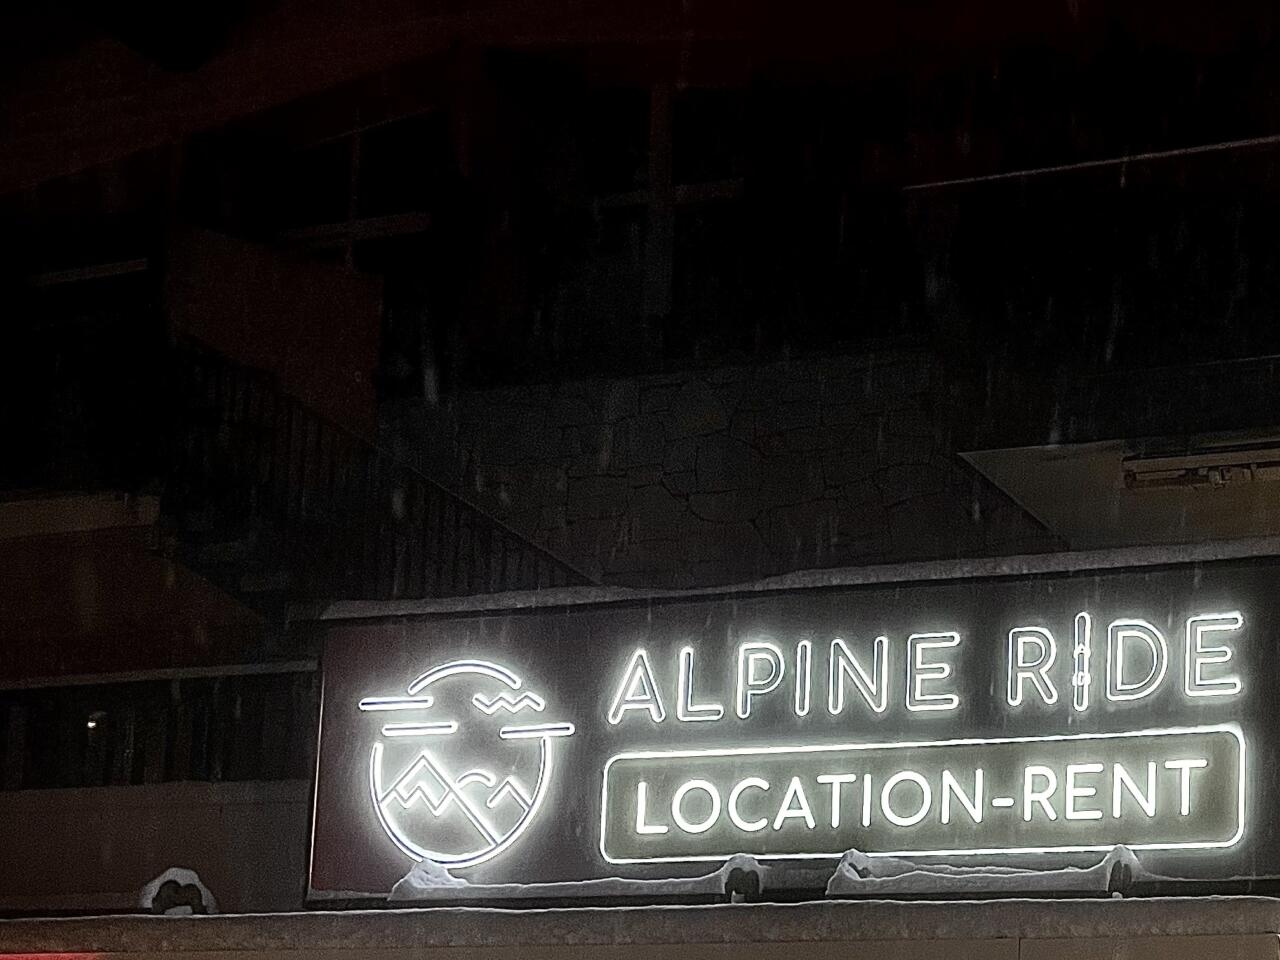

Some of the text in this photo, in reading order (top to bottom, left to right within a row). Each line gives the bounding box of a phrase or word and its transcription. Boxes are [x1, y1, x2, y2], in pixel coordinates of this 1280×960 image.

[608, 611, 1246, 726] ALPINE RIDE
[634, 758, 1209, 836] LOCATION-RENT
